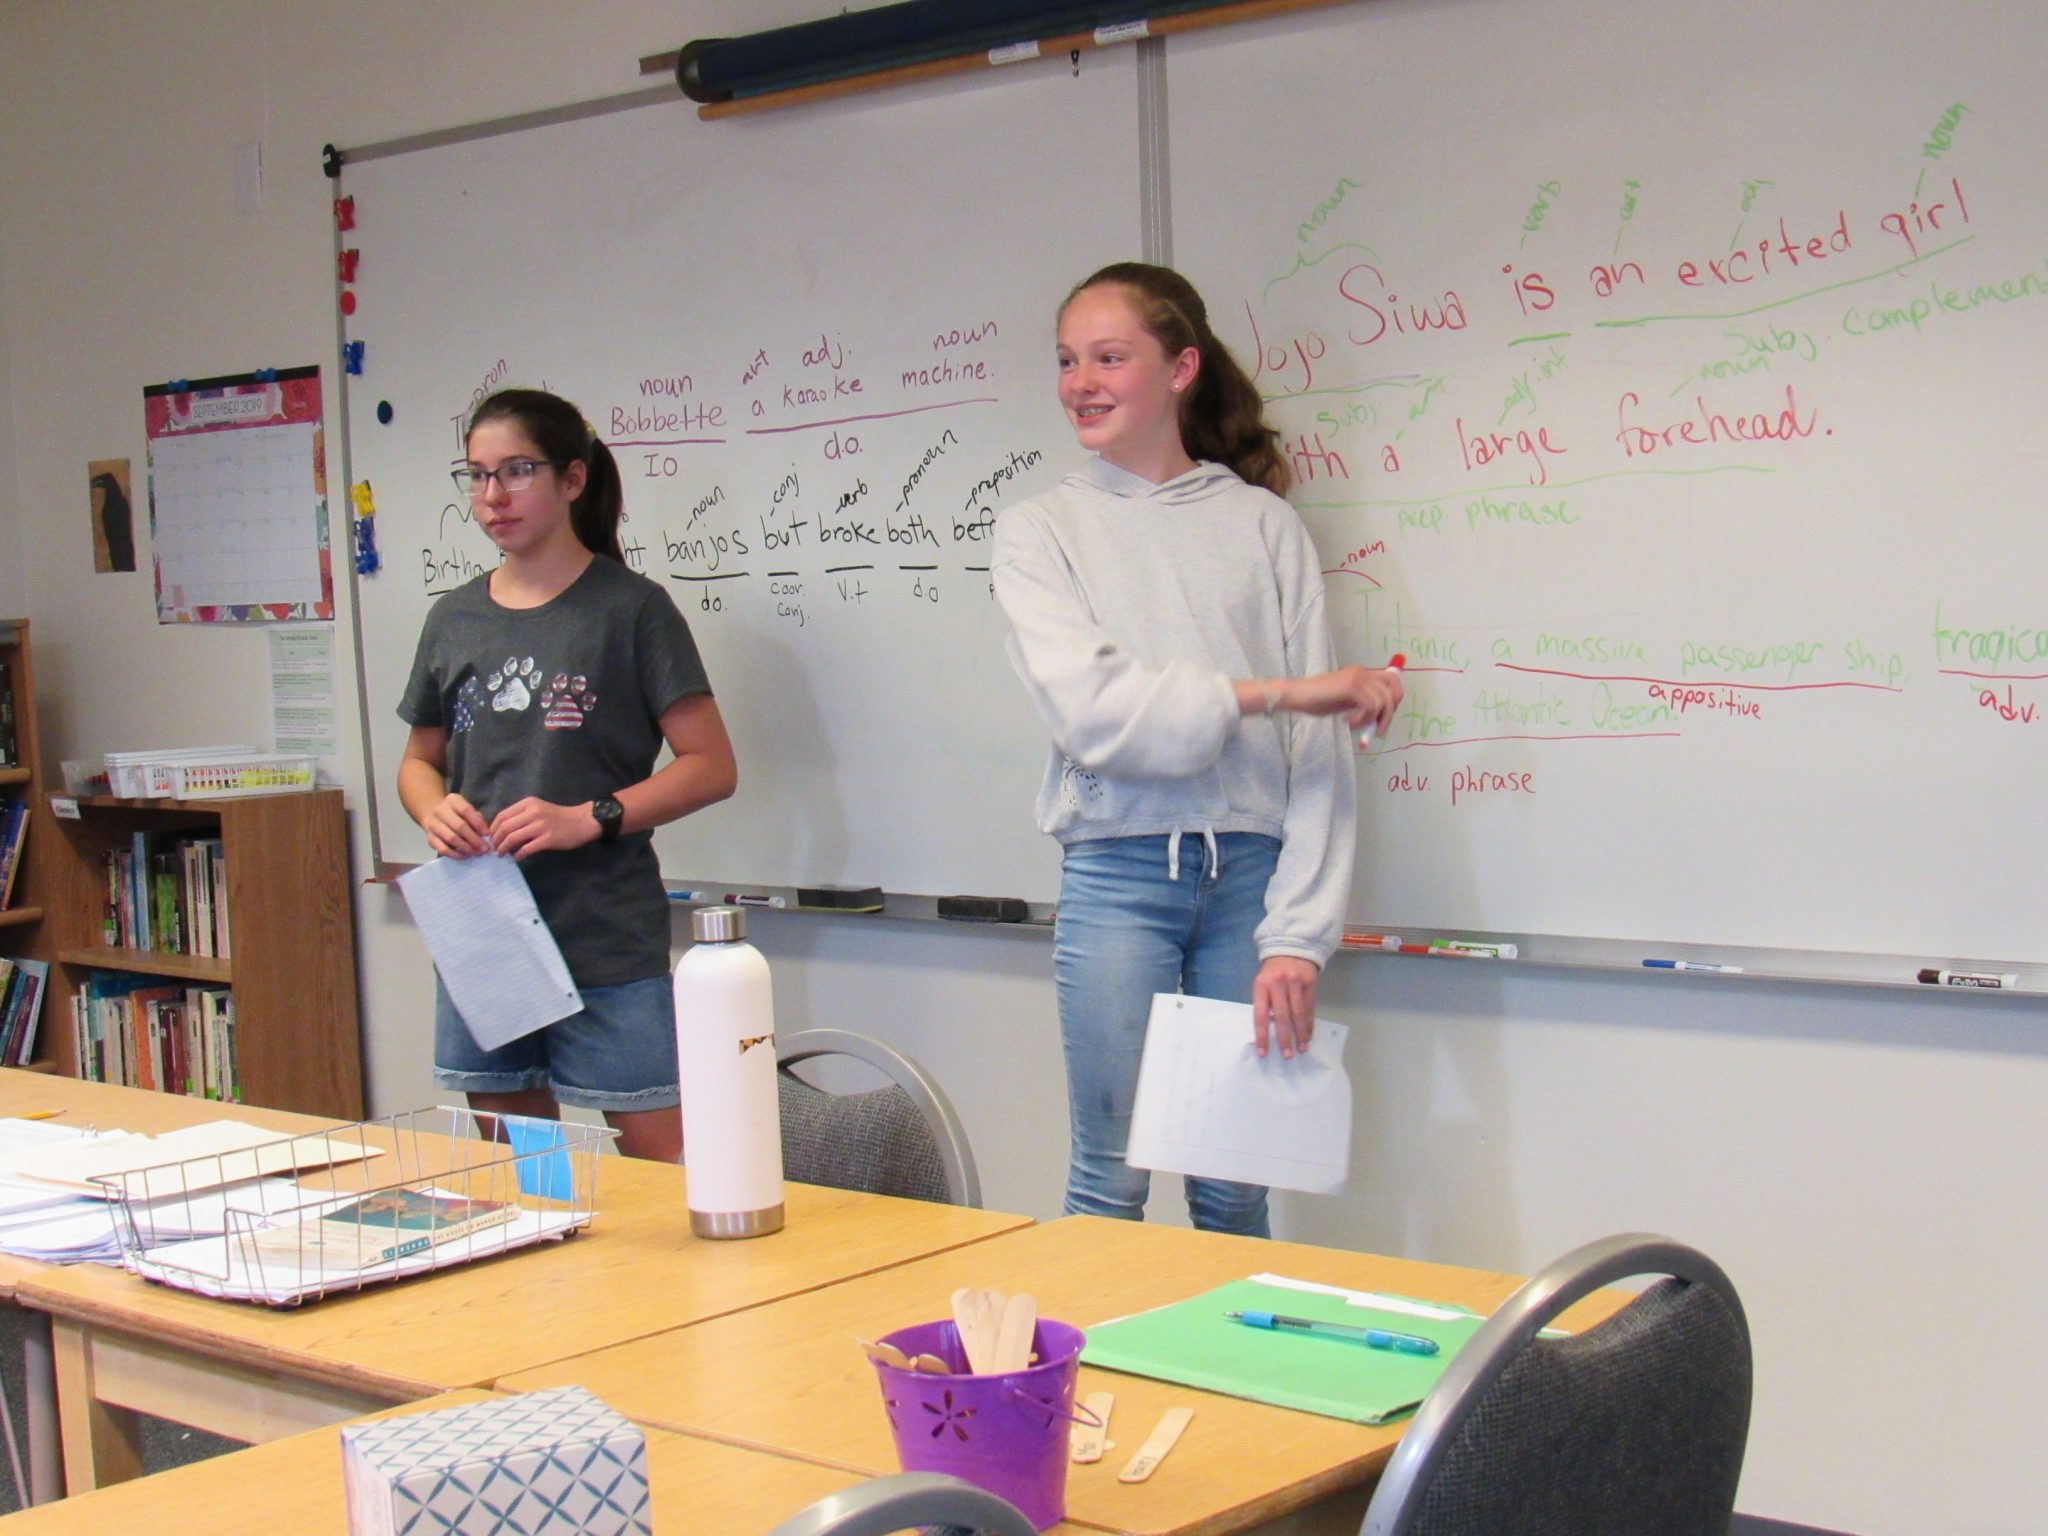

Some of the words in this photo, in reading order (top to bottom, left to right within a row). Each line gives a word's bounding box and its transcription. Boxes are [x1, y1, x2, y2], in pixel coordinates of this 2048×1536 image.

[1298, 177, 1364, 243] noun
[1338, 263, 1468, 346] Siwa
[1502, 263, 1556, 316] is
[1589, 262, 1645, 298] an
[1677, 209, 1852, 287] excited
[1879, 176, 1969, 279] girl
[1842, 266, 2048, 337] complemen
[802, 332, 852, 370] adj.
[933, 320, 998, 350] noun
[639, 373, 693, 400] noun
[742, 347, 770, 386] art
[241, 398, 263, 413] 2019
[610, 405, 727, 437] Bobbette
[751, 399, 766, 418] a
[901, 357, 996, 390] machine.
[1284, 432, 1349, 484] ith
[1381, 444, 1400, 472] a
[1455, 417, 1567, 486] large
[1616, 384, 1834, 457] forehead.
[773, 462, 800, 504] conj
[902, 428, 959, 507] pronoun
[969, 449, 1043, 505] preposition
[691, 485, 726, 521] noun
[663, 530, 749, 572] banjos
[760, 510, 808, 549] but
[818, 511, 881, 544] broke
[886, 513, 941, 549] both
[1347, 539, 1386, 565] noun
[1491, 638, 1514, 659] a
[1536, 632, 1647, 664] massive
[1681, 640, 1824, 682] passenger
[1403, 691, 1457, 741] the
[1648, 683, 1763, 721] appositive
[1979, 684, 2041, 722] adv.
[1387, 761, 1431, 794] adv.
[1451, 765, 1537, 806] phrase
[383, 1238, 429, 1258] CINEROS
